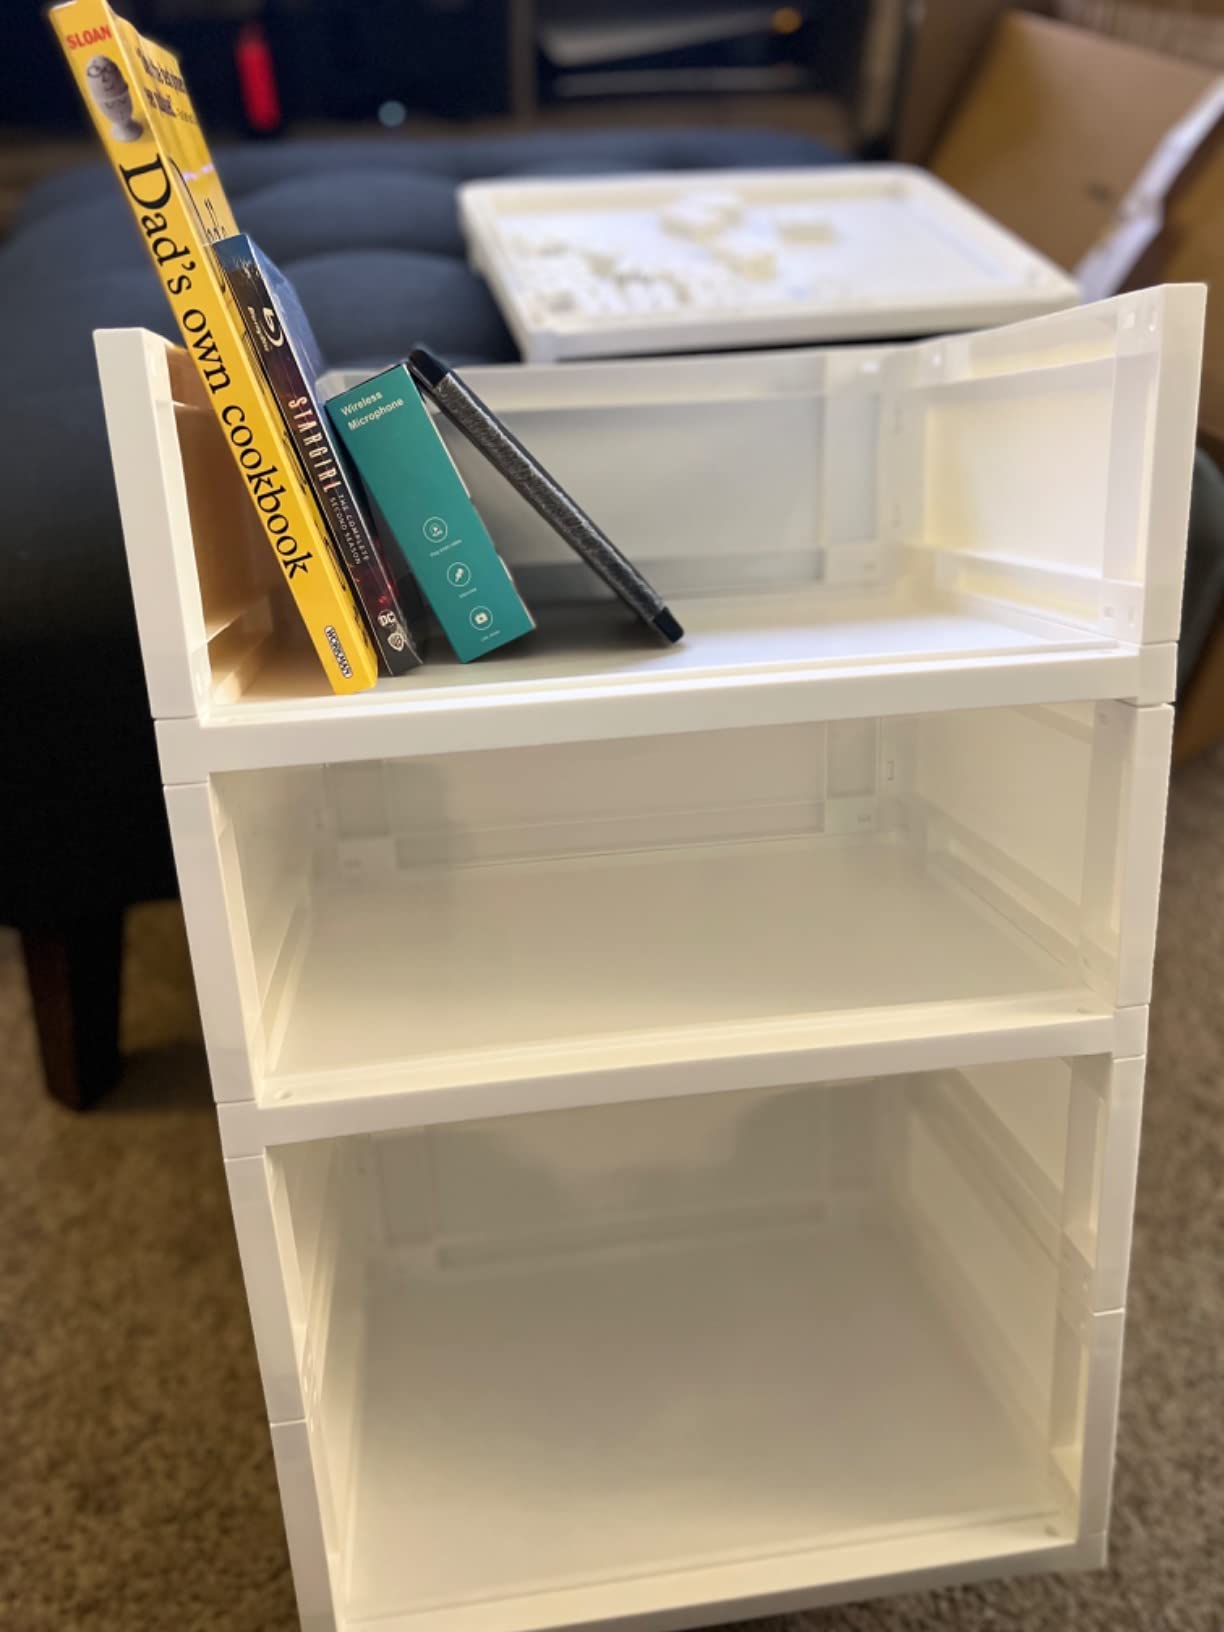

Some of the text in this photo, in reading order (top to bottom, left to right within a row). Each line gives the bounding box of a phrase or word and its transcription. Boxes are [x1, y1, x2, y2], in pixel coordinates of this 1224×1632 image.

[66, 24, 113, 51] SLOAN
[119, 153, 197, 296] Dad's
[182, 308, 231, 394] own
[221, 404, 313, 580] cookbook
[340, 391, 383, 416] Wireless
[347, 398, 404, 431] Microphone
[287, 396, 342, 492] STARGIRL
[330, 496, 361, 565] SECOND SEASON
[338, 494, 369, 560] THE COMPLETE
